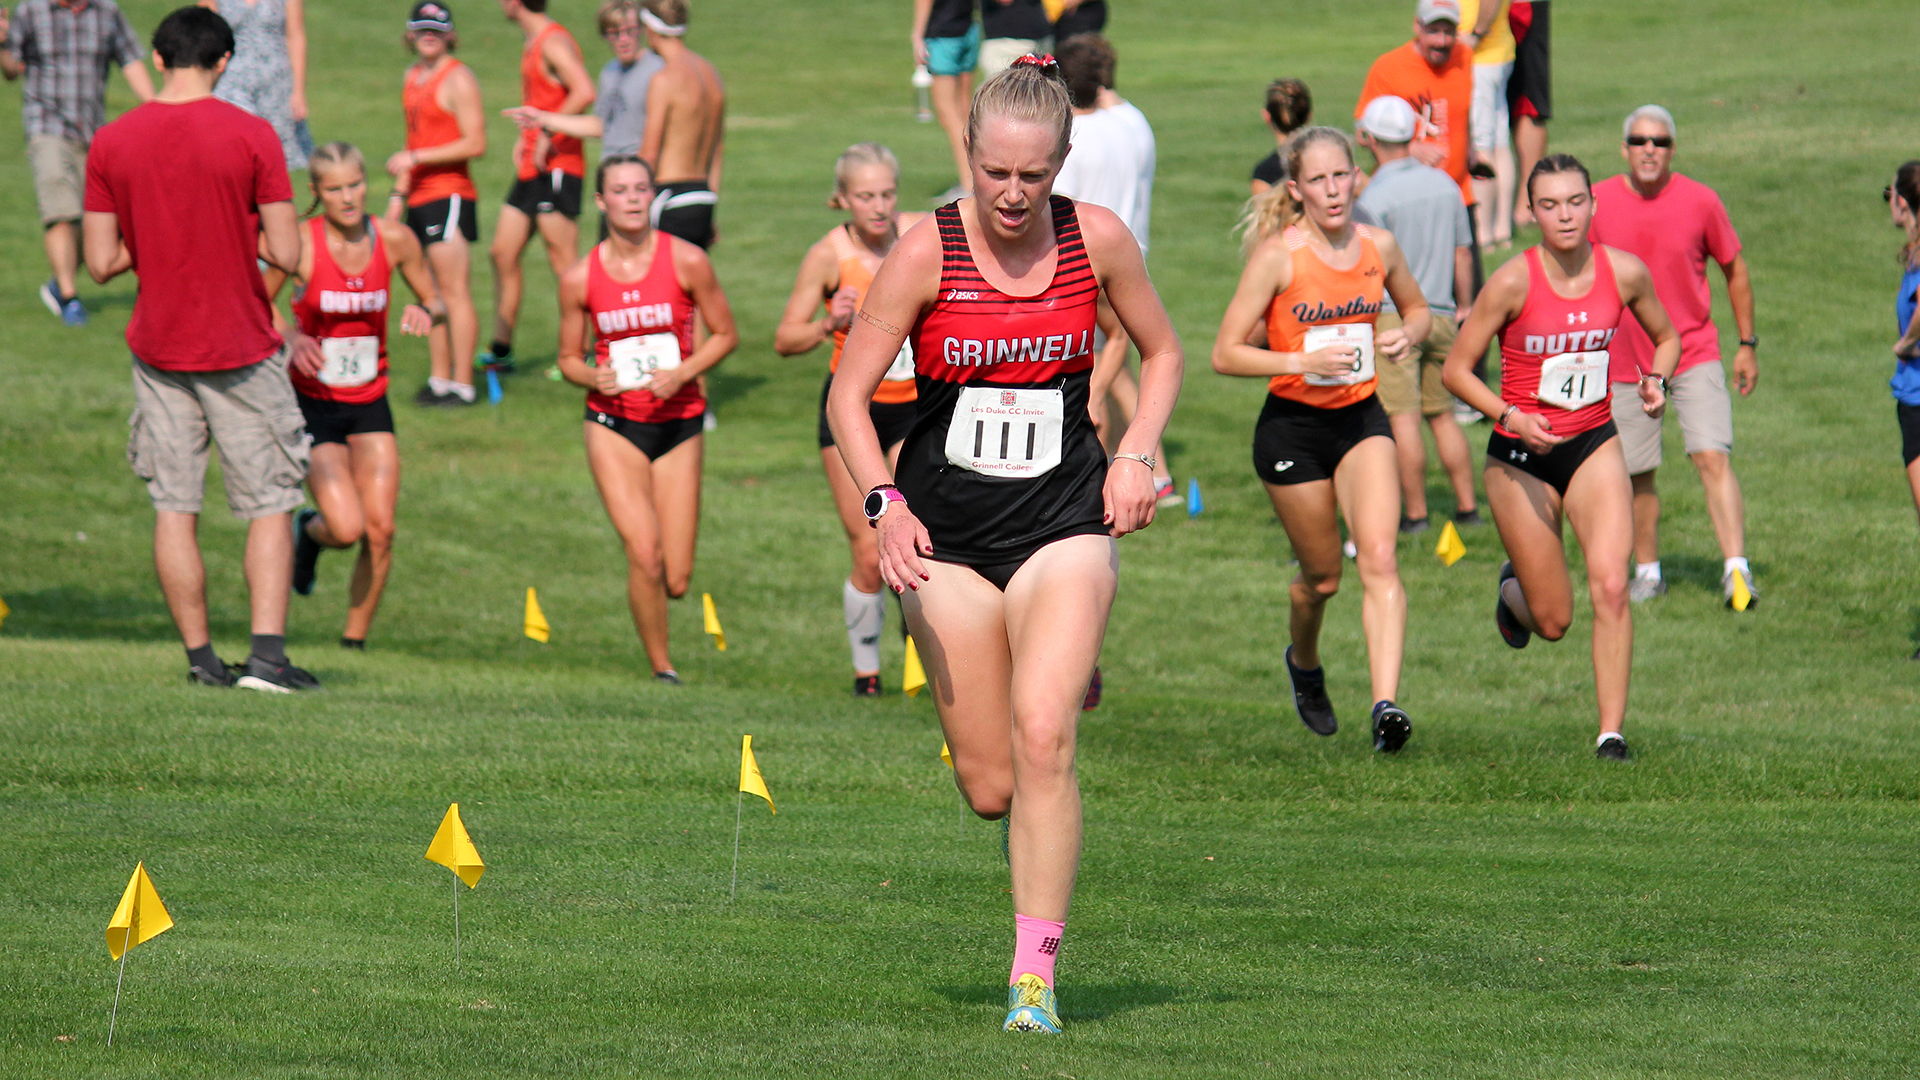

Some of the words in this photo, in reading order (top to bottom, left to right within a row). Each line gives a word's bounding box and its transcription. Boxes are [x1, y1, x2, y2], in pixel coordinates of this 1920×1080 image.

[321, 289, 387, 313] DUTCH
[955, 290, 979, 301] asics
[596, 302, 673, 334] DUTCH
[943, 329, 1089, 368] GRINNELL
[338, 354, 360, 376] 36
[1560, 374, 1587, 399] 41
[986, 406, 1006, 414] Duke
[1008, 407, 1021, 415] CC
[1023, 408, 1045, 416] Invite
[973, 420, 1036, 461] 111
[972, 461, 1003, 470] Grinnell
[1005, 463, 1034, 472] College
